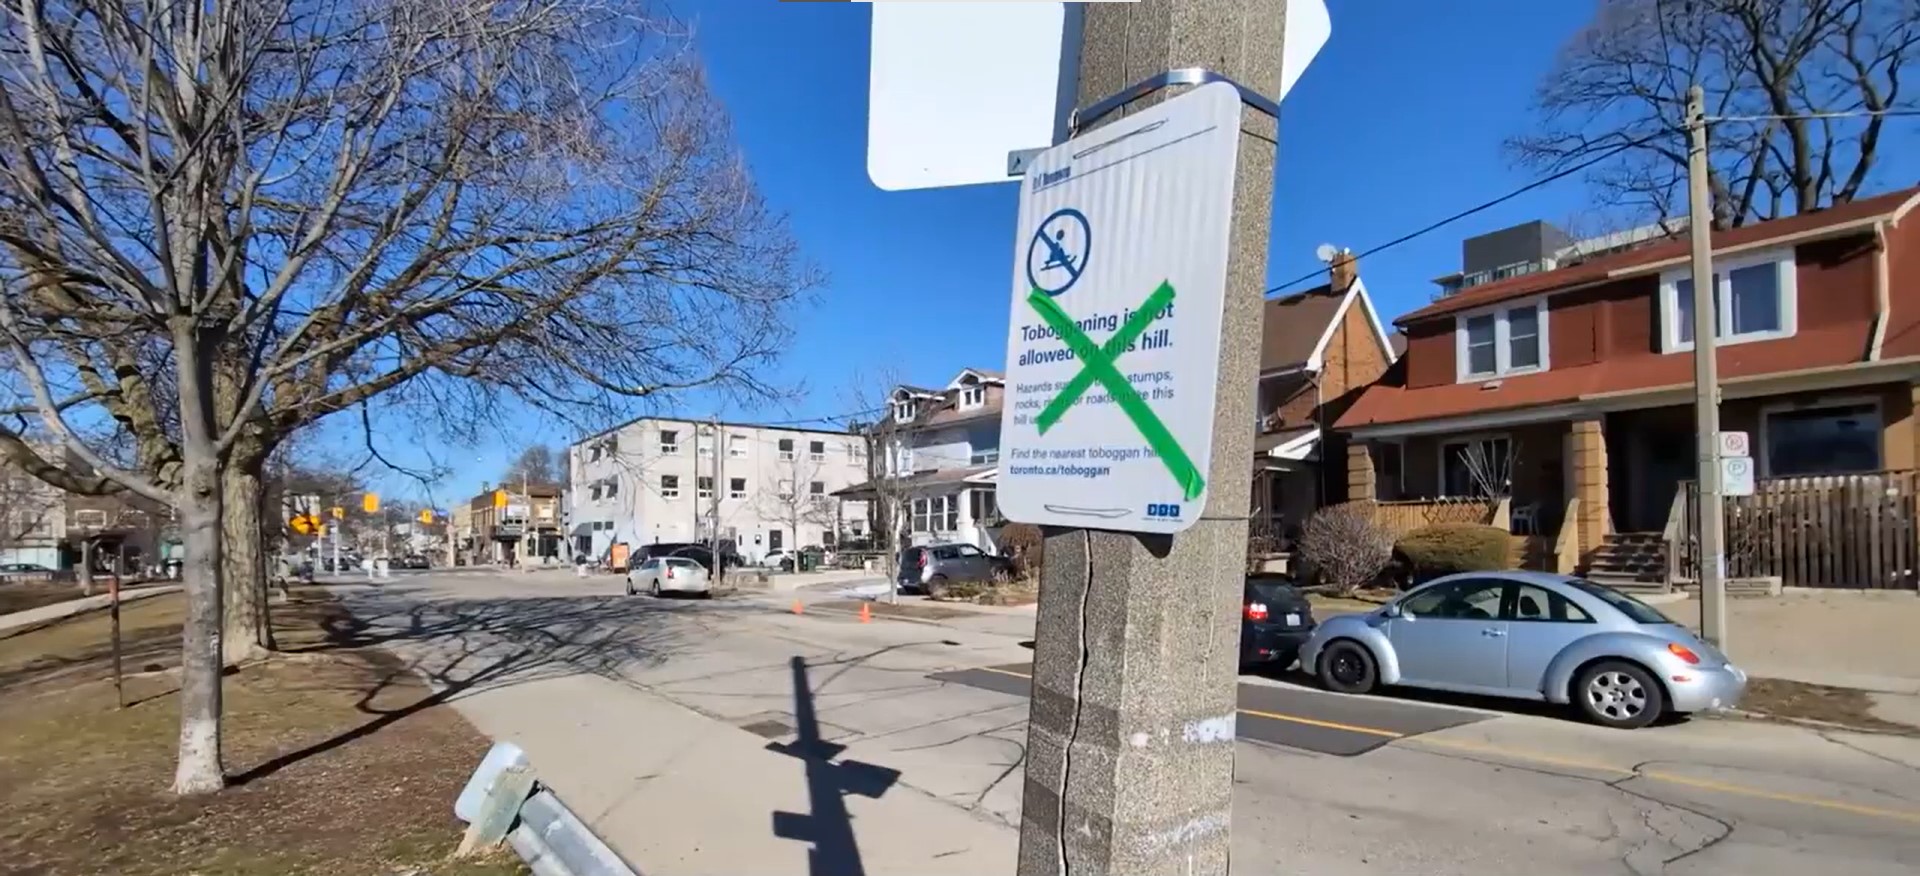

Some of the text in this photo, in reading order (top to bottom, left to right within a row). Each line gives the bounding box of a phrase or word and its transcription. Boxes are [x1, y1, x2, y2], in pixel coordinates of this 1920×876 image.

[1019, 346, 1075, 366] allowed
[1142, 329, 1174, 350] hill.
[1152, 385, 1174, 400] this
[1010, 446, 1161, 461] Find the nearest toboggan hi
[1009, 464, 1111, 478] toronto.ca/toboggan
